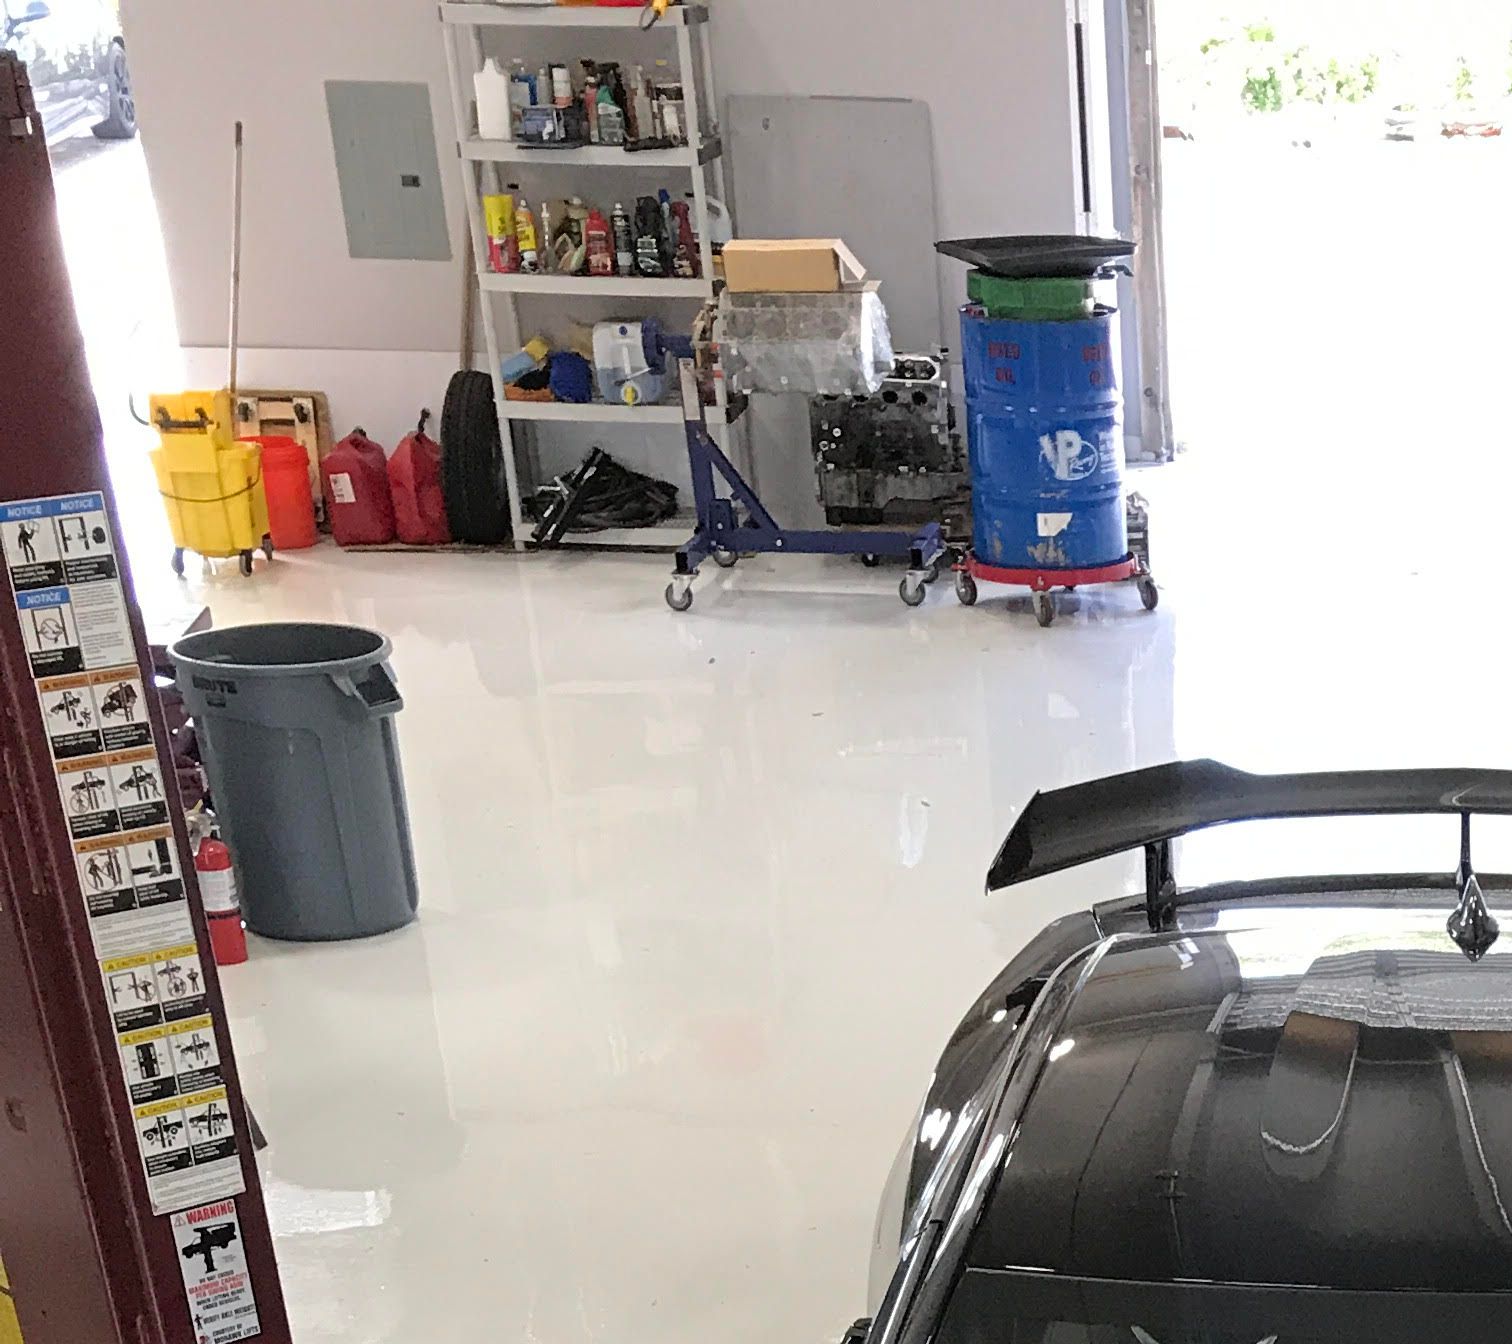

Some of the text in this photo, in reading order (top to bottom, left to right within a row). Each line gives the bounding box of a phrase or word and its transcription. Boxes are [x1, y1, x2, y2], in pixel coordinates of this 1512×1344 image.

[7, 505, 42, 518] NOTICE
[60, 498, 95, 512] NOTICE
[26, 592, 62, 605] NOTICE
[186, 1200, 235, 1225] WARNING
